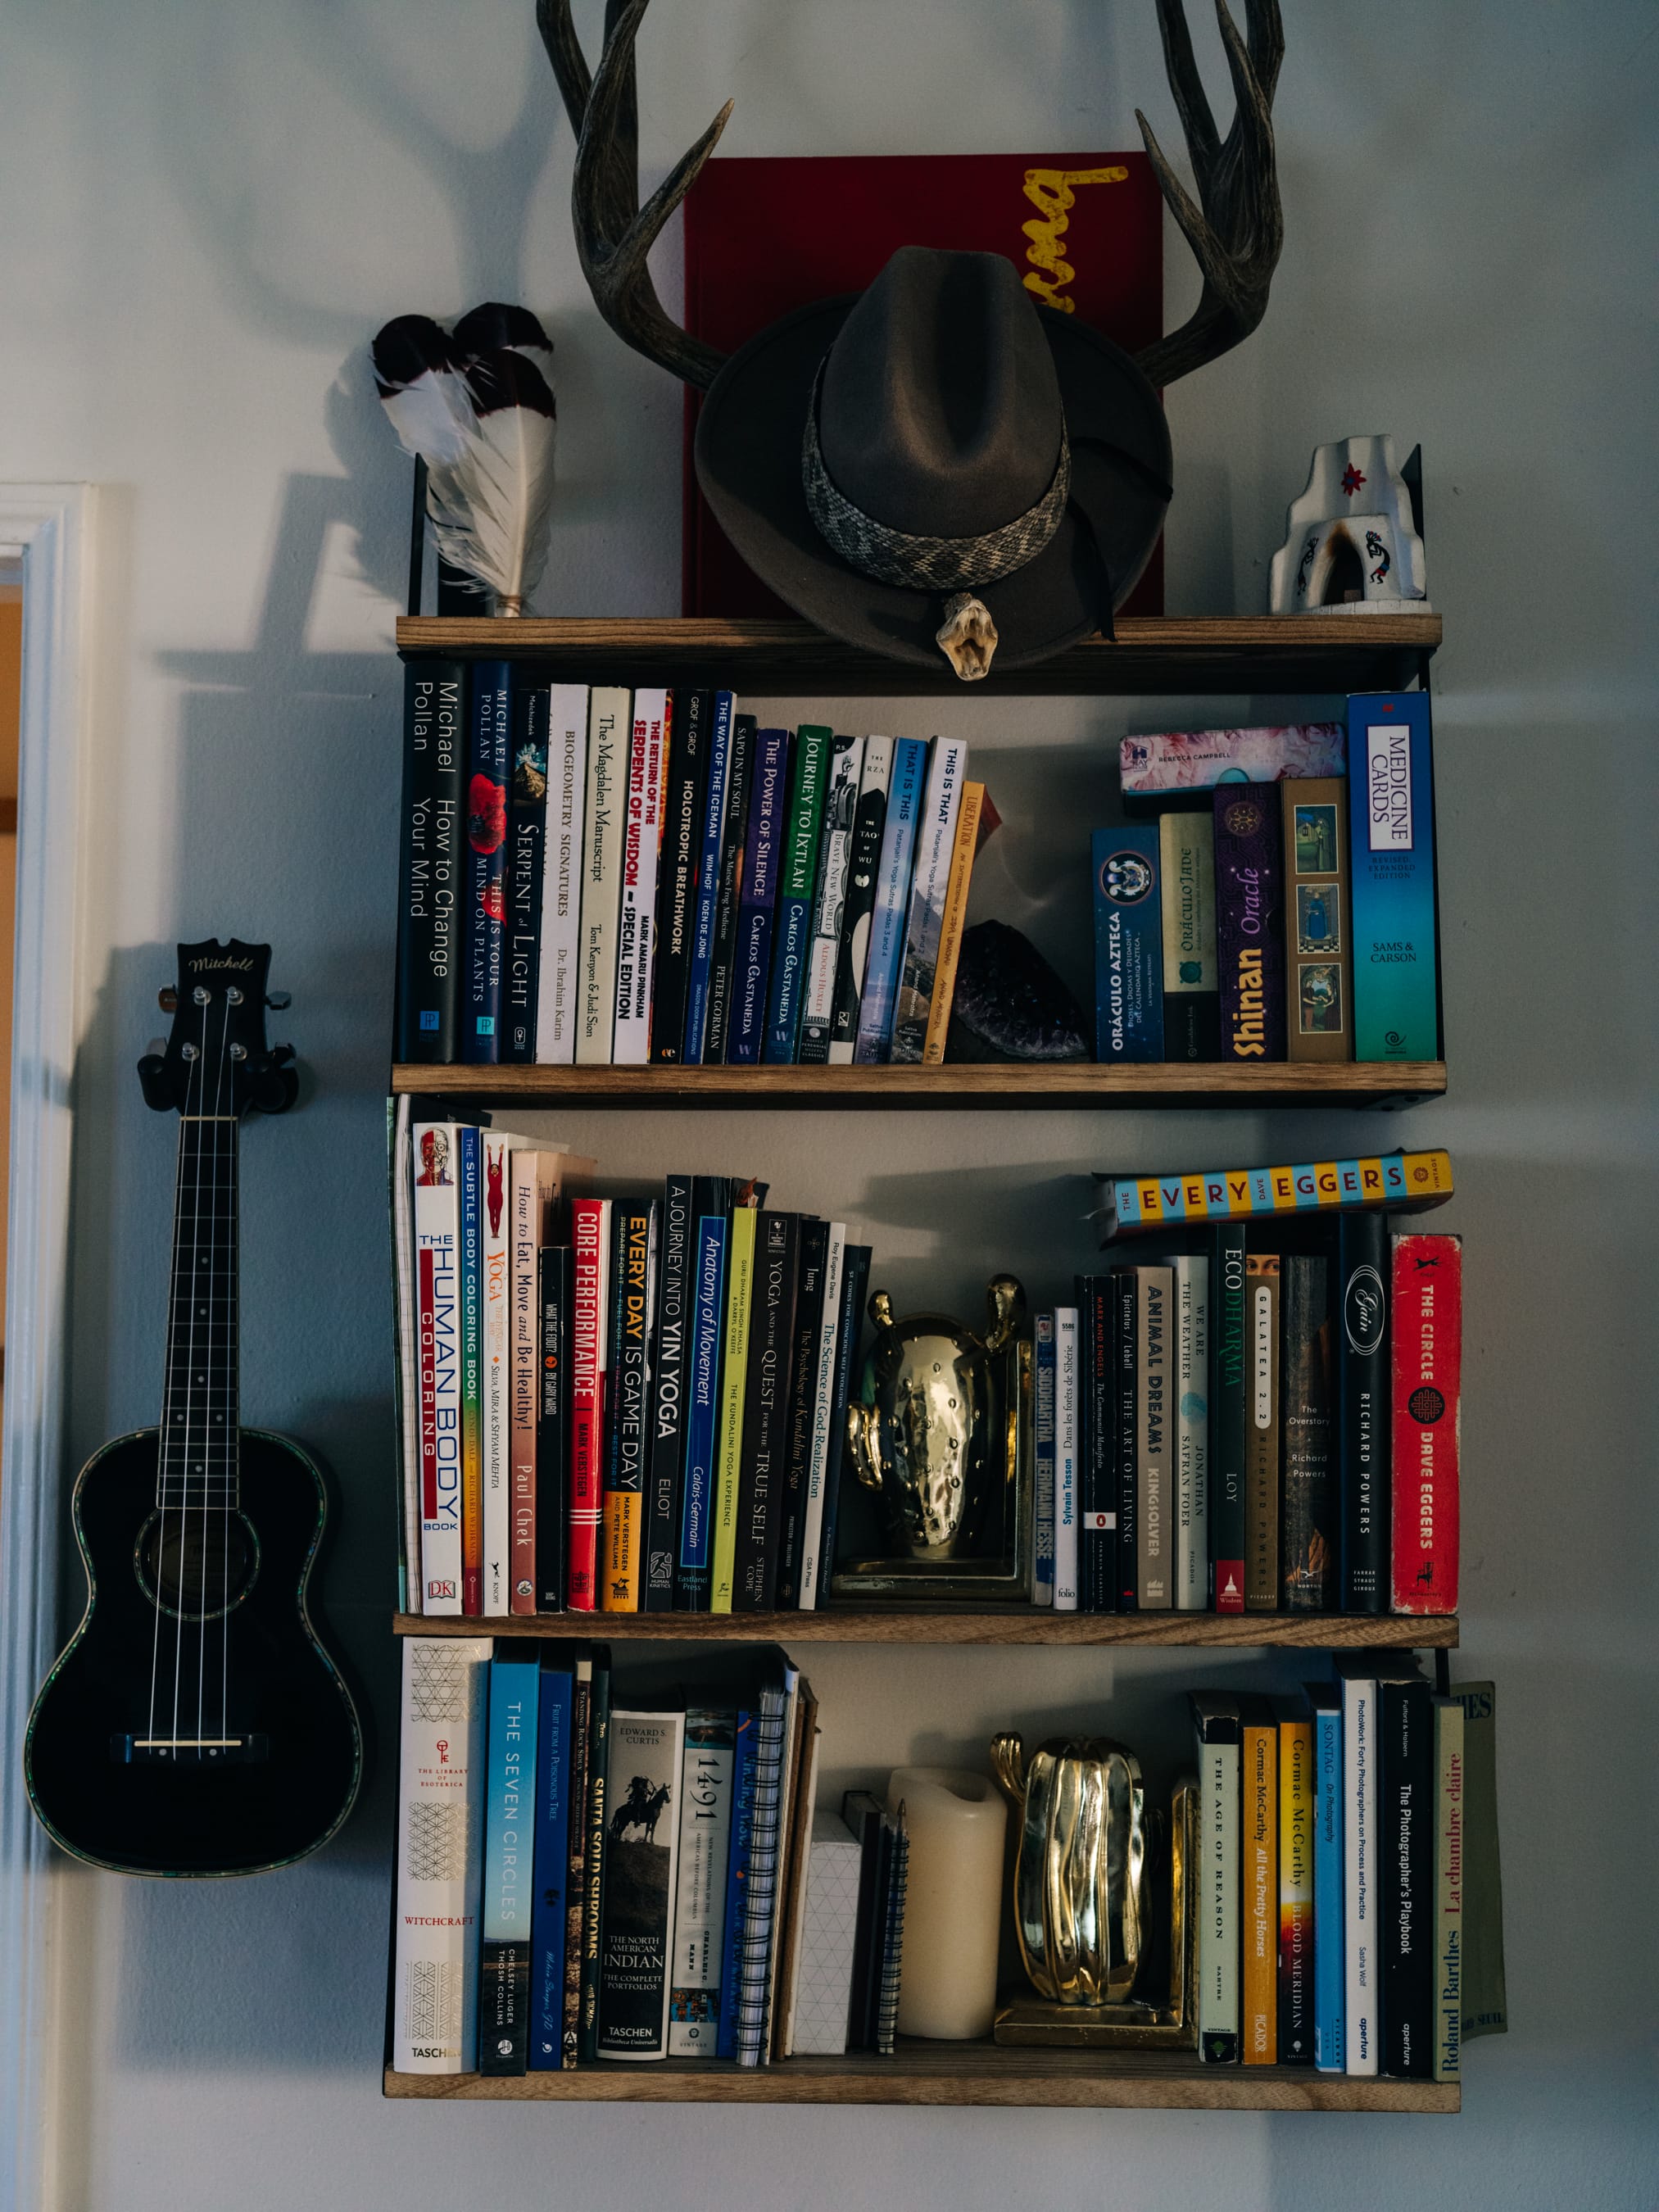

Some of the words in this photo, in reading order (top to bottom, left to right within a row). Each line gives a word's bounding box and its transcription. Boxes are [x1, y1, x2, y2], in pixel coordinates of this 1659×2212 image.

[414, 682, 433, 750] Pollan
[437, 682, 458, 772] Michael
[480, 695, 491, 760] POLLAN
[495, 690, 507, 765] MICHAEL
[528, 696, 536, 736] Melchizedek
[599, 714, 614, 741] The
[562, 731, 575, 827] BIOGEOMETRY
[595, 744, 614, 806] Magdalen
[630, 721, 647, 792] SERPENTS
[800, 736, 822, 805] JOURNEY
[1158, 755, 1190, 763] REBECCA
[629, 798, 642, 818] OF
[1371, 755, 1389, 823] CARDS
[1389, 737, 1408, 840] MEDICINE
[412, 798, 431, 850] Your
[436, 800, 456, 851] How
[678, 780, 694, 863] HOLOTROPIC
[799, 809, 812, 829] TO
[435, 859, 452, 880] to
[590, 810, 610, 882] Manuscript
[625, 822, 641, 886] WISDOM
[792, 833, 812, 888] IXTLAN
[832, 834, 843, 862] BRAVE
[410, 860, 429, 917] Mind
[476, 858, 487, 901] MIND
[491, 873, 501, 913] THIS
[558, 835, 571, 917] SIGNATURES
[830, 864, 840, 890] NEW
[475, 909, 485, 930] ON
[670, 866, 688, 955] BREATHWORK
[825, 896, 837, 930] WORLD
[1236, 868, 1261, 935] Oracle
[429, 890, 454, 977] Change
[491, 920, 500, 934] IS
[622, 907, 637, 960] SPECIAL
[749, 915, 765, 963] CARLOS
[786, 904, 804, 953] CARLOS
[1108, 912, 1122, 971] AZTECA
[1373, 942, 1403, 951] SAMS
[1405, 942, 1414, 951] &
[188, 955, 254, 972] Mitchell
[474, 938, 485, 1001] PLANTS
[489, 941, 500, 986] YOUR
[557, 950, 567, 964] Dr.
[1371, 953, 1416, 963] CARSON
[555, 968, 567, 1006] Ibrahim
[619, 964, 632, 1019] EDITION
[742, 965, 760, 1036] CASTANEDA
[778, 954, 798, 1024] CASTANEDA
[1232, 948, 1266, 1057] Shinan
[555, 1010, 564, 1040] Karim
[1108, 975, 1124, 1050] ORÁCULO
[672, 1186, 686, 1197] A
[1143, 1181, 1247, 1209] EVERY
[1258, 1177, 1266, 1200] DAVE
[1276, 1167, 1402, 1197] EGGERS
[1430, 1158, 1440, 1190] VINTAGE
[419, 1235, 453, 1244] THE
[577, 1213, 597, 1257] CORE
[628, 1217, 647, 1290] EVERY
[668, 1201, 685, 1273] JOURNEY
[487, 1251, 505, 1302] YOGA
[699, 1235, 721, 1306] Anatomy
[805, 1267, 818, 1292] Jung
[627, 1296, 644, 1340] DAY
[665, 1277, 682, 1316] INTO
[702, 1308, 717, 1326] of
[1218, 1248, 1243, 1387] ECODHARMA
[1355, 1289, 1379, 1333] Gain
[1421, 1285, 1434, 1317] THE
[434, 1249, 456, 1393] HUMAN
[573, 1264, 597, 1396] PERFORMANCE
[661, 1321, 682, 1361] YIN
[1149, 1285, 1163, 1367] ANIMAL
[625, 1346, 642, 1364] IS
[696, 1326, 716, 1406] Movement
[1421, 1323, 1434, 1380] CIRCLE
[422, 1312, 434, 1456] COLORING
[623, 1371, 641, 1435] GAME
[658, 1369, 679, 1439] YOGA
[1149, 1376, 1163, 1453] DREAMS
[1289, 1417, 1330, 1426] Overstory
[1301, 1405, 1317, 1414] The
[1361, 1393, 1370, 1462] RICHARD
[437, 1407, 458, 1519] BODY
[621, 1442, 639, 1489] DAY
[1063, 1458, 1072, 1490] Tesson
[1292, 1453, 1327, 1462] Richard
[1293, 1470, 1326, 1478] Powers
[1420, 1431, 1434, 1477] DAVE
[517, 1465, 533, 1498] Paul
[657, 1478, 671, 1520] ELIOT
[1226, 1473, 1237, 1502] LOY
[1360, 1473, 1370, 1534] POWERS
[517, 1507, 533, 1545] Chek
[688, 1466, 704, 1548] Calais-Germain
[1063, 1492, 1074, 1525] Sylvain
[1148, 1467, 1160, 1557] KINGSOLVER
[1420, 1484, 1434, 1549] EGGERS
[430, 1582, 453, 1597] DK
[678, 1575, 707, 1584] Eastland
[682, 1583, 701, 1591] Press
[746, 1566, 755, 1593] COPE
[755, 1557, 764, 1602] STEPHEN
[1058, 1588, 1075, 1598] folio
[506, 1702, 521, 1742] THE
[620, 1728, 658, 1736] EDWARD
[627, 1737, 660, 1745] CURTIS
[1292, 1739, 1305, 1801] Cormac
[1324, 1724, 1334, 1775] SONTAG
[1357, 1746, 1366, 1767] Forty
[504, 1752, 519, 1820] SEVEN
[690, 1757, 723, 1820] 1491
[1357, 1769, 1366, 1820] Photographers
[1400, 1784, 1412, 1806] The
[1446, 1753, 1462, 1802] claire
[1290, 1808, 1305, 1887] McCarthy
[1359, 1821, 1364, 1833] on
[1445, 1808, 1461, 1884] chambre
[501, 1832, 518, 1920] CIRCLES
[1398, 1809, 1412, 1897] Photographer's
[405, 1916, 474, 1925] WITCHCRAFT
[1444, 1890, 1460, 1914] La
[609, 1935, 627, 1944] THE
[628, 1937, 660, 1945] NORTH
[610, 1944, 656, 1953] AMERICAN
[1292, 1906, 1302, 1953] BLOOD
[1398, 1901, 1412, 1954] Playbook
[507, 1949, 515, 1989] CHELSEY
[604, 1953, 664, 1968] INDIAN
[1443, 1931, 1459, 2000] Barthes
[1292, 1959, 1303, 2028] MERIDIAN
[609, 2027, 653, 2037] TASCHEN
[1442, 2009, 1458, 2072] Roland
